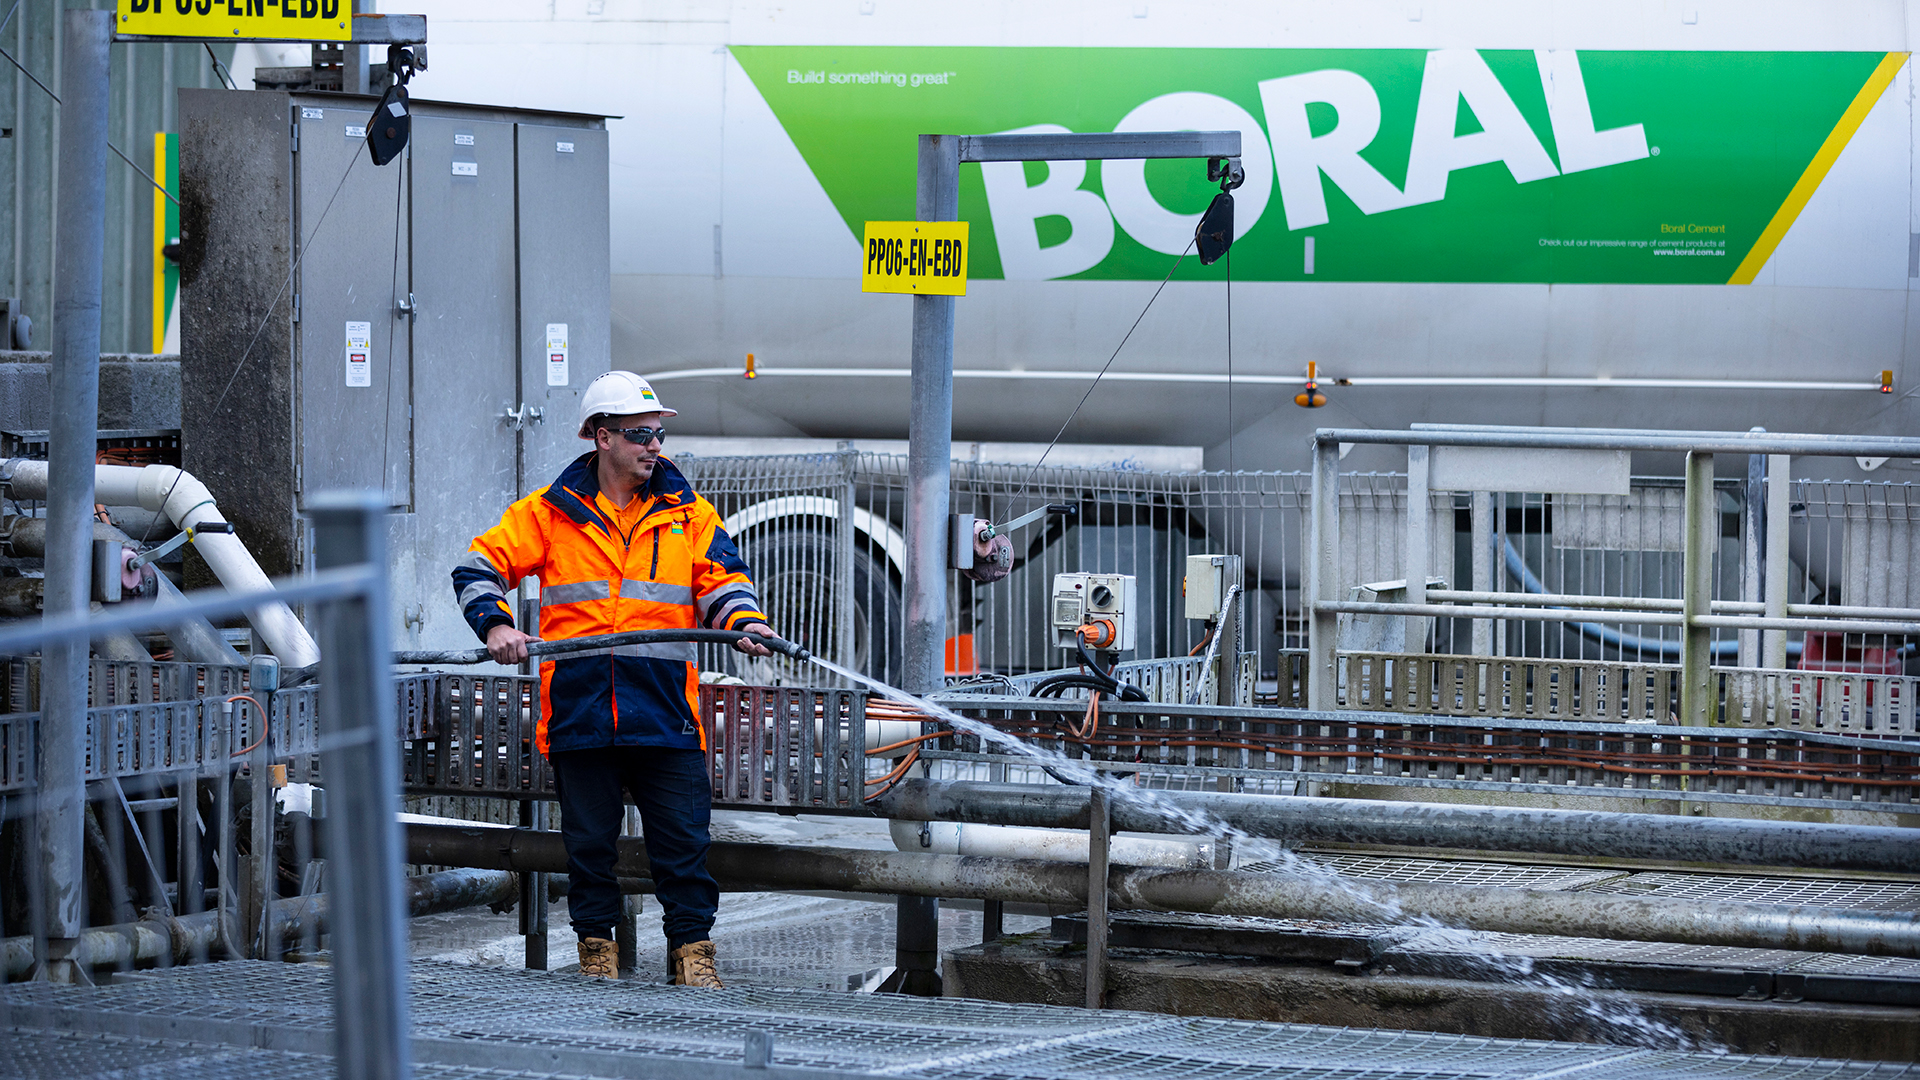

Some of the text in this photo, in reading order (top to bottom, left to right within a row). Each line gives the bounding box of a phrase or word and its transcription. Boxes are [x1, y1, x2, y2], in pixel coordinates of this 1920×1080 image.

[787, 69, 825, 84] Build
[828, 70, 907, 87] something
[979, 49, 1650, 282] BORAL
[1661, 223, 1726, 234] Boral Cement
[1538, 238, 1562, 247] Check
[1563, 239, 1575, 247] out
[1627, 240, 1648, 249] range
[1649, 239, 1657, 247] of
[1657, 239, 1685, 247] cement
[1685, 239, 1717, 249] products
[1718, 239, 1726, 248] at
[867, 238, 962, 277] PP06-EN-EBD
[1653, 248, 1726, 256] www.boral.com.au
